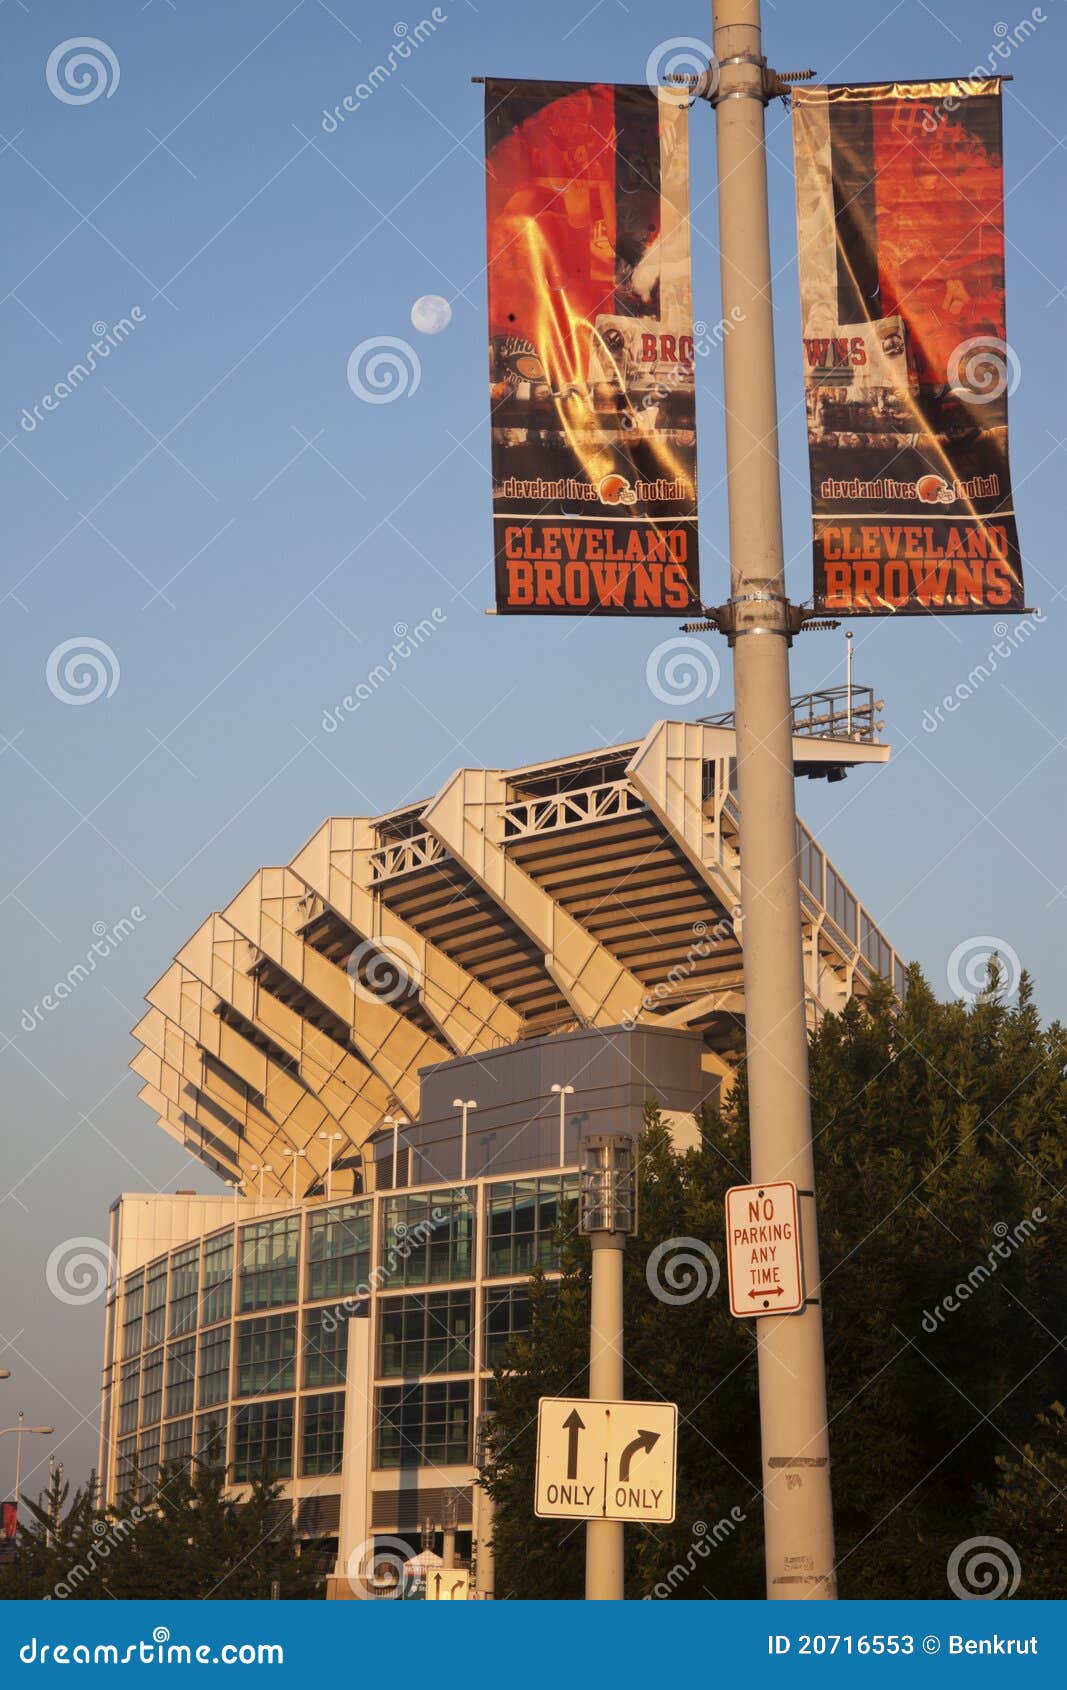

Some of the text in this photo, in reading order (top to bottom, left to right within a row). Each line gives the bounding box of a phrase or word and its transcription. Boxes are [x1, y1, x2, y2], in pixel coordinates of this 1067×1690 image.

[803, 336, 867, 367] WNS
[503, 477, 686, 500] cleveland lives football
[820, 473, 1000, 499] cleveland lives football
[505, 526, 688, 563] CLEVELAND
[823, 526, 1009, 560] CLEVELAND
[506, 560, 689, 609] BROWNS
[824, 559, 1012, 609] BROWNS
[748, 1198, 774, 1223] NO
[733, 1223, 792, 1246] PARKING
[751, 1246, 777, 1265] ANY
[749, 1266, 781, 1285] TIME
[546, 1484, 595, 1506] ONLY
[615, 1487, 663, 1509] ONLY
